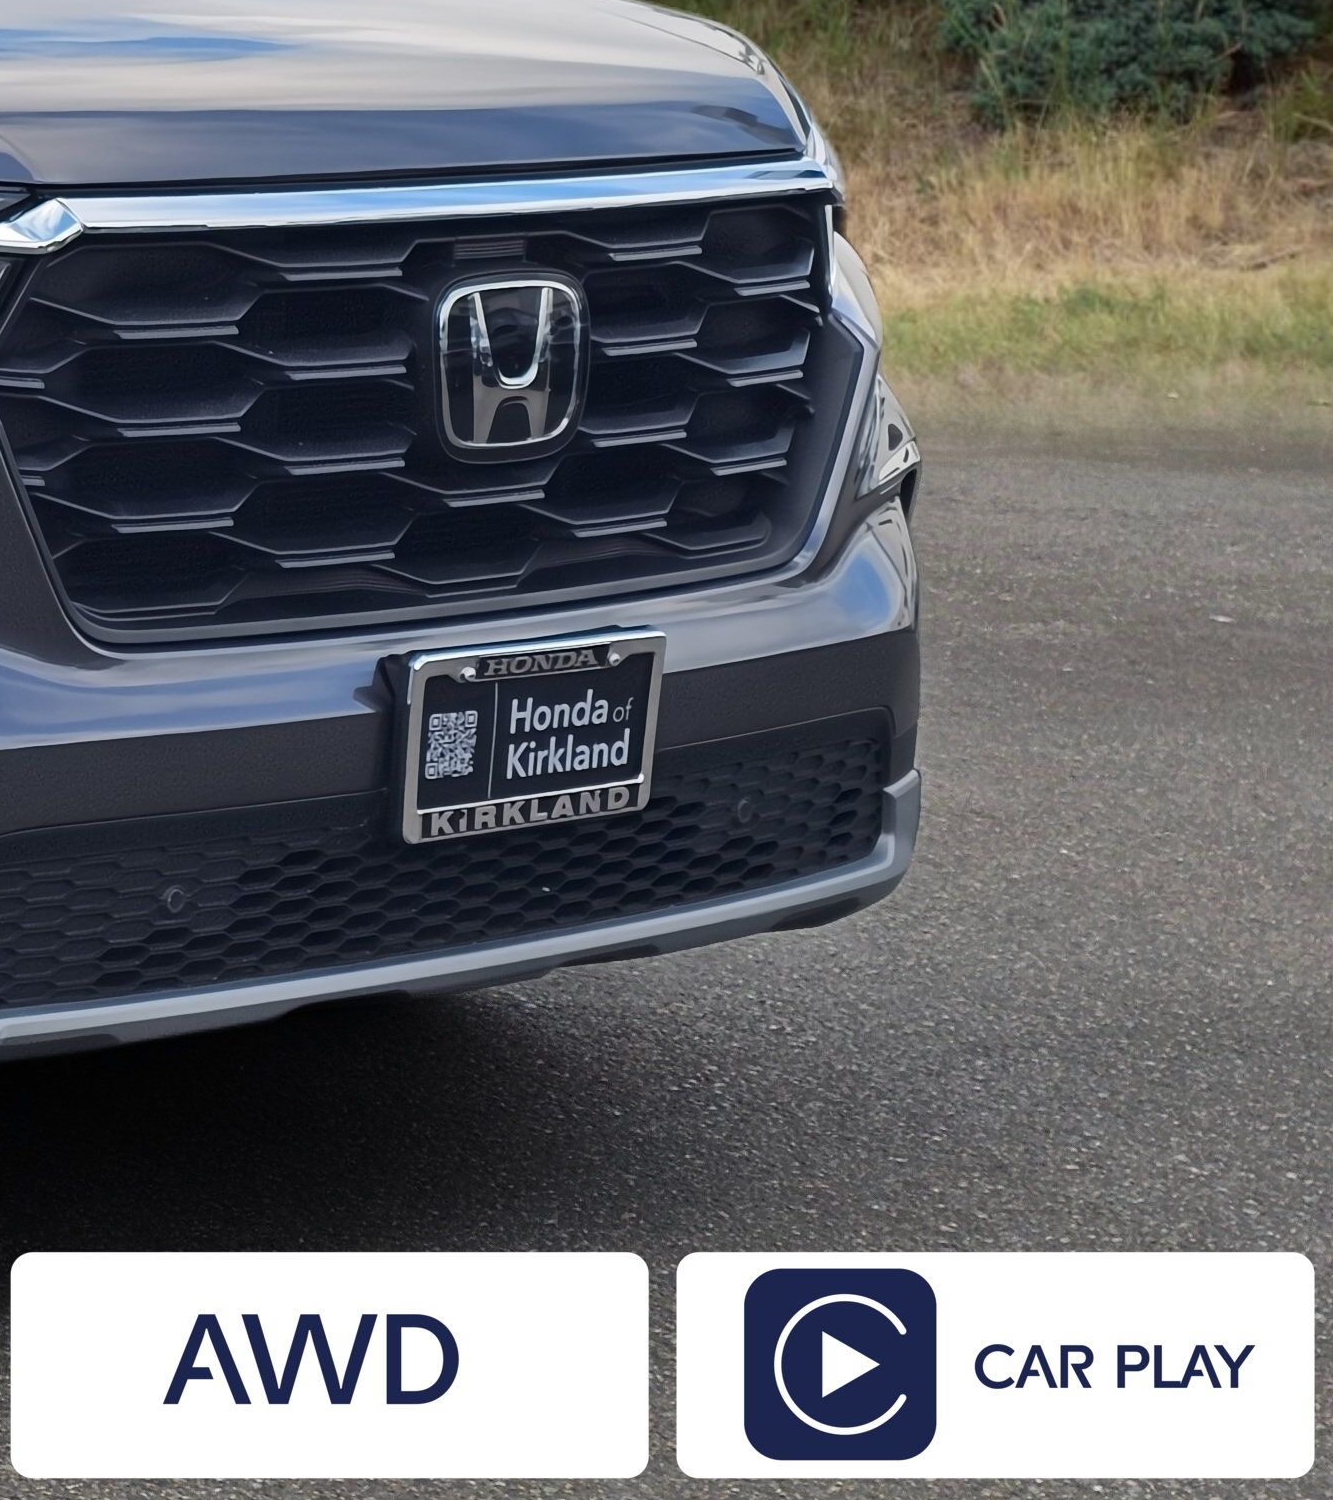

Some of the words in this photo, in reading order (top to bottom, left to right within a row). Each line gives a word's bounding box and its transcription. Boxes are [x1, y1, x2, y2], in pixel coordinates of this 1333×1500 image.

[484, 649, 599, 677] HONDA
[509, 688, 609, 734] Honda
[612, 697, 634, 722] of
[505, 727, 630, 779] Kirkland
[430, 785, 630, 836] KIRKLAND
